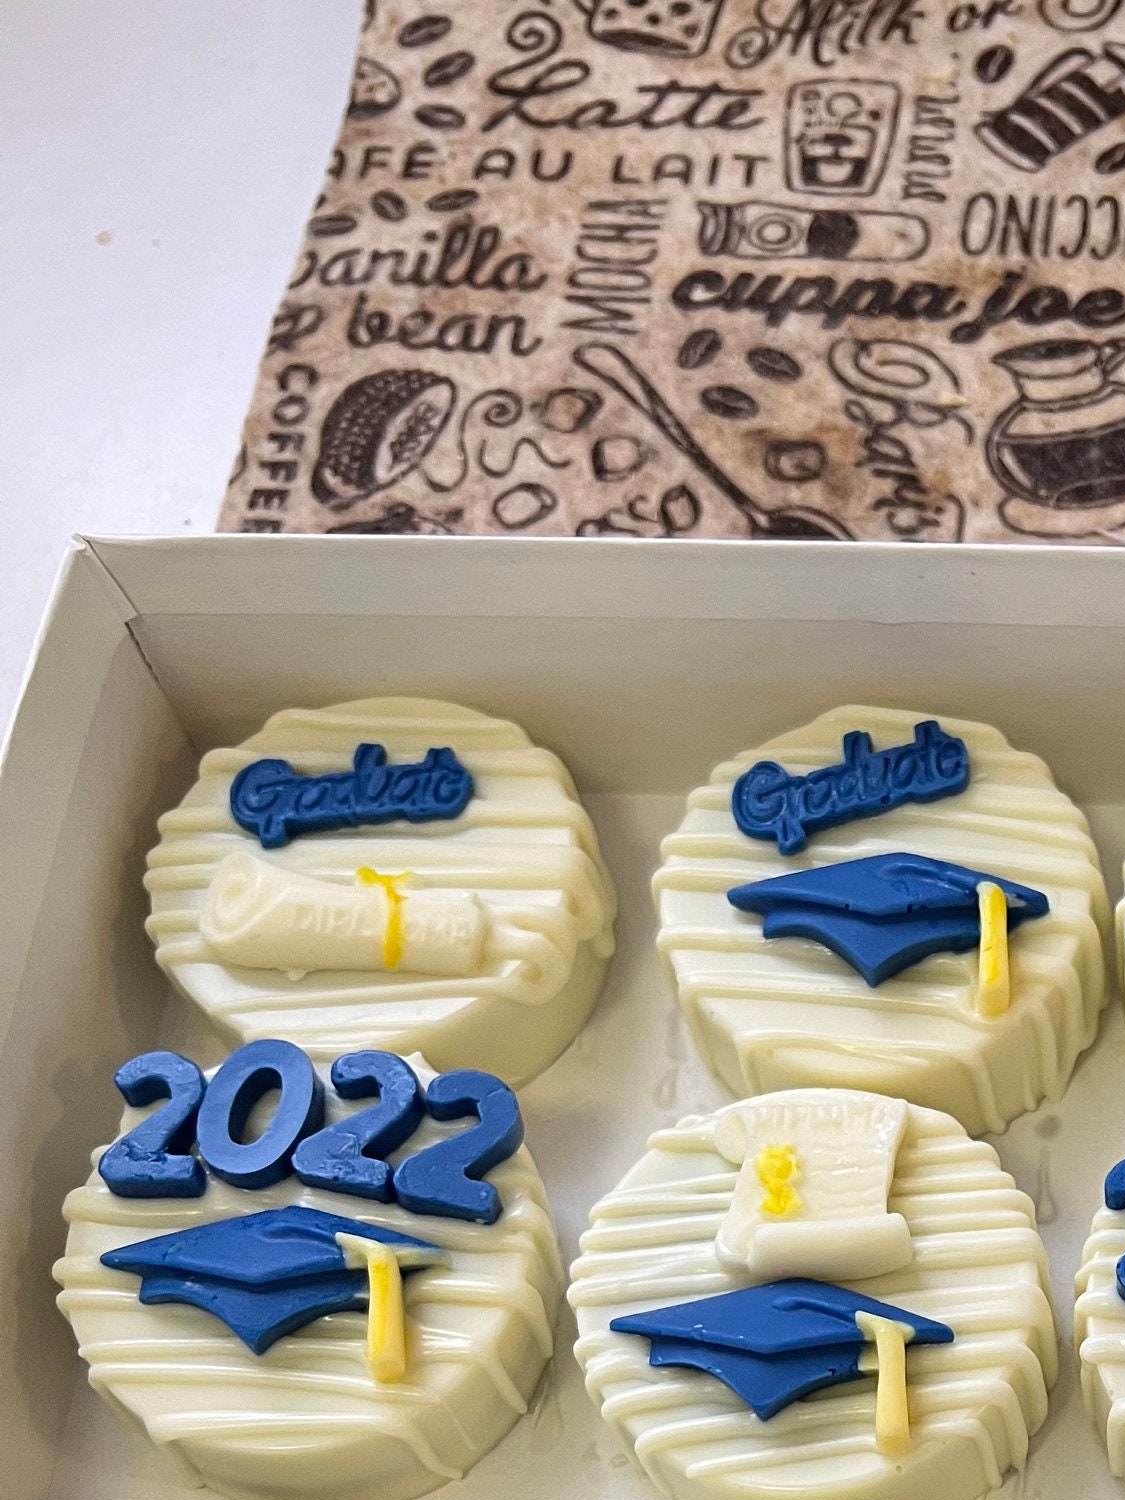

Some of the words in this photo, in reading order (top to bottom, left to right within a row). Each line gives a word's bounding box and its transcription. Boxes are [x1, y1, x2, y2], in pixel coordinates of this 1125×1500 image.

[473, 148, 574, 182] AU
[611, 153, 770, 187] LAIT
[346, 290, 544, 357] bean
[561, 198, 669, 336] MOCHA
[229, 742, 475, 850] Graduate
[731, 720, 970, 857] Graduate
[98, 1038, 526, 1226] 2022
